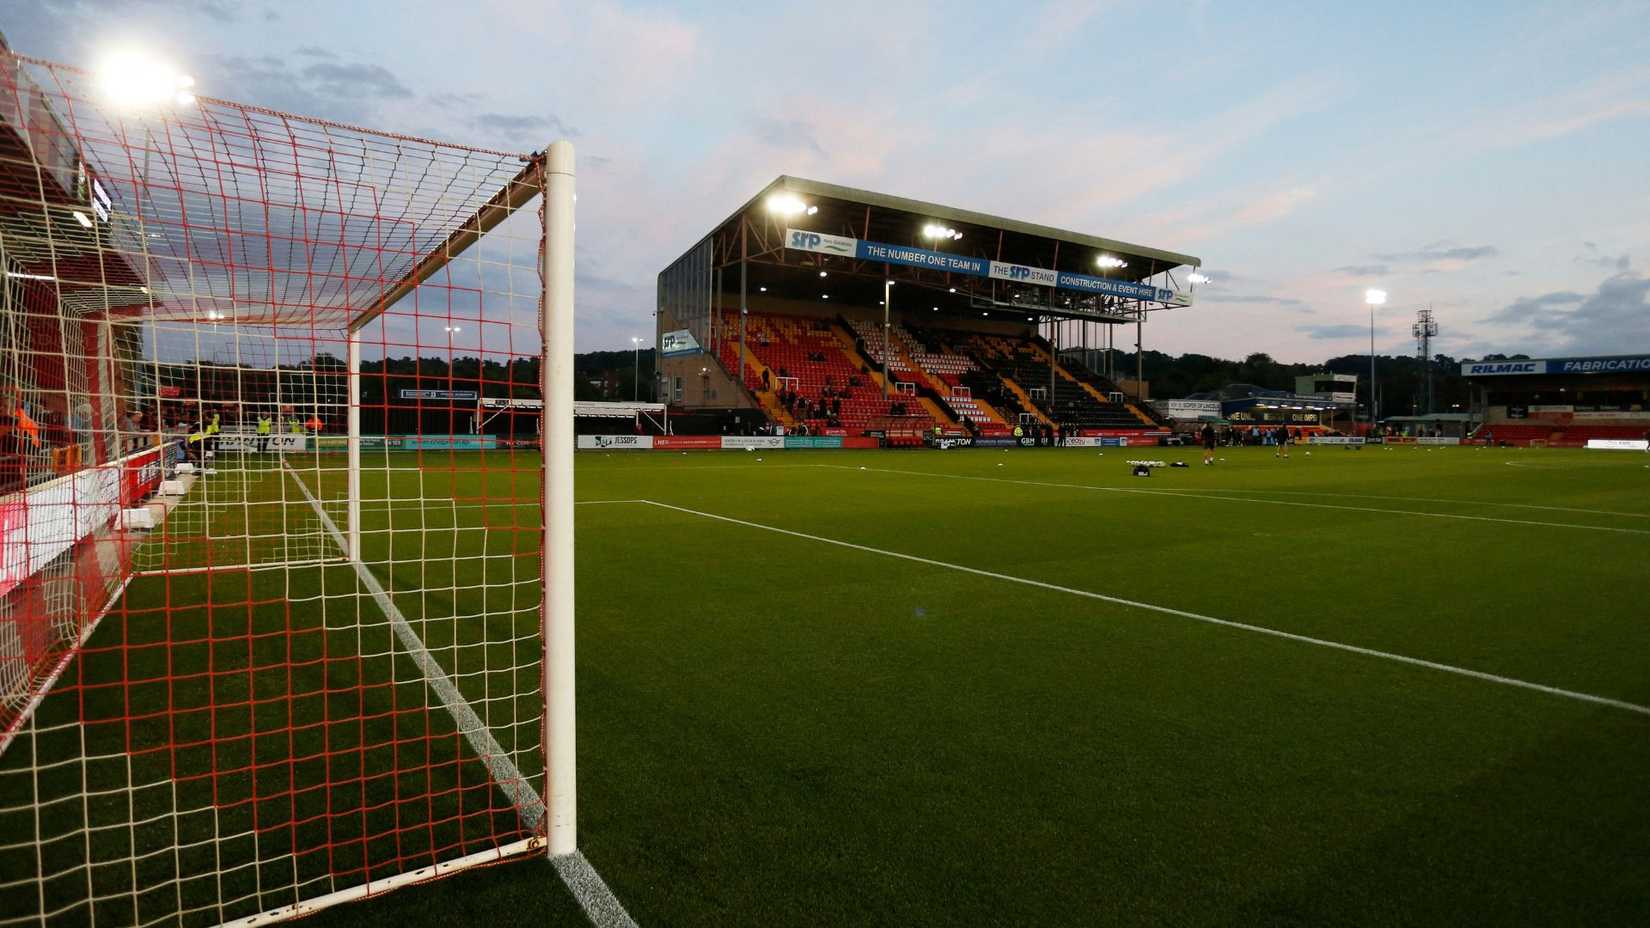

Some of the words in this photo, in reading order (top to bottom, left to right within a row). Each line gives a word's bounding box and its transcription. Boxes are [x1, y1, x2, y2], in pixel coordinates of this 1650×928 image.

[867, 245, 886, 257] THE
[888, 249, 926, 263] NUMBER
[928, 255, 946, 266] ONE
[948, 258, 970, 270] TEAM
[971, 262, 981, 272] IN
[993, 265, 1009, 276] THE
[1032, 271, 1055, 282] STAND
[1060, 275, 1111, 291] CONSTRUCTION
[1119, 284, 1138, 294] EVENT
[1139, 287, 1153, 297] HIRE
[1471, 363, 1537, 374] RILMAC
[614, 436, 637, 444] JESSOPS
